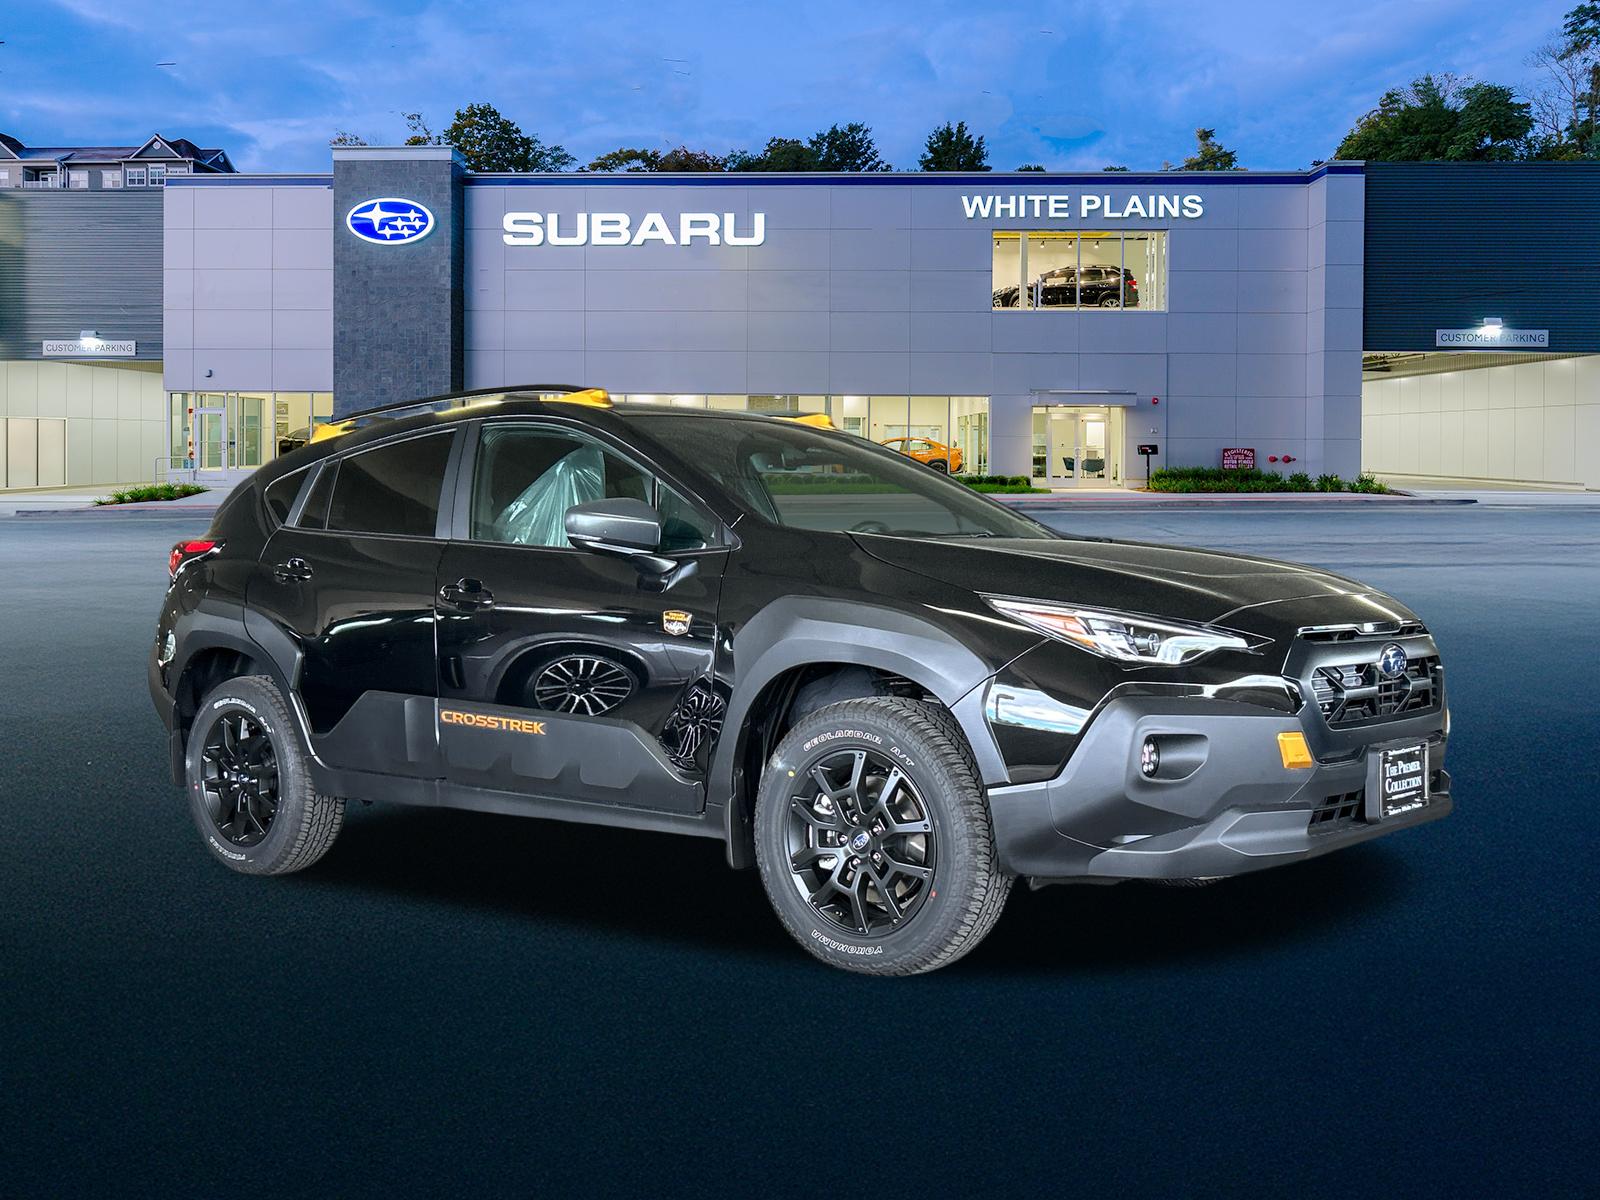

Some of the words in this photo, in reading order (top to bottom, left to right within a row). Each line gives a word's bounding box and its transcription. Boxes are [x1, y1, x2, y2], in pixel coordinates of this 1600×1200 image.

[961, 195, 1070, 219] WHITE
[1080, 195, 1205, 219] PLAINS
[502, 212, 766, 246] SUBARU
[45, 343, 92, 352] CUSTOMER
[94, 343, 133, 352] PARKING
[1440, 333, 1497, 343] CUSTOMER
[1500, 333, 1546, 343] PARKING
[440, 710, 546, 735] CROSSTREK
[803, 729, 883, 752] GEOLANDAR
[889, 746, 915, 767] A/T
[811, 929, 883, 956] YOKOHAMA
